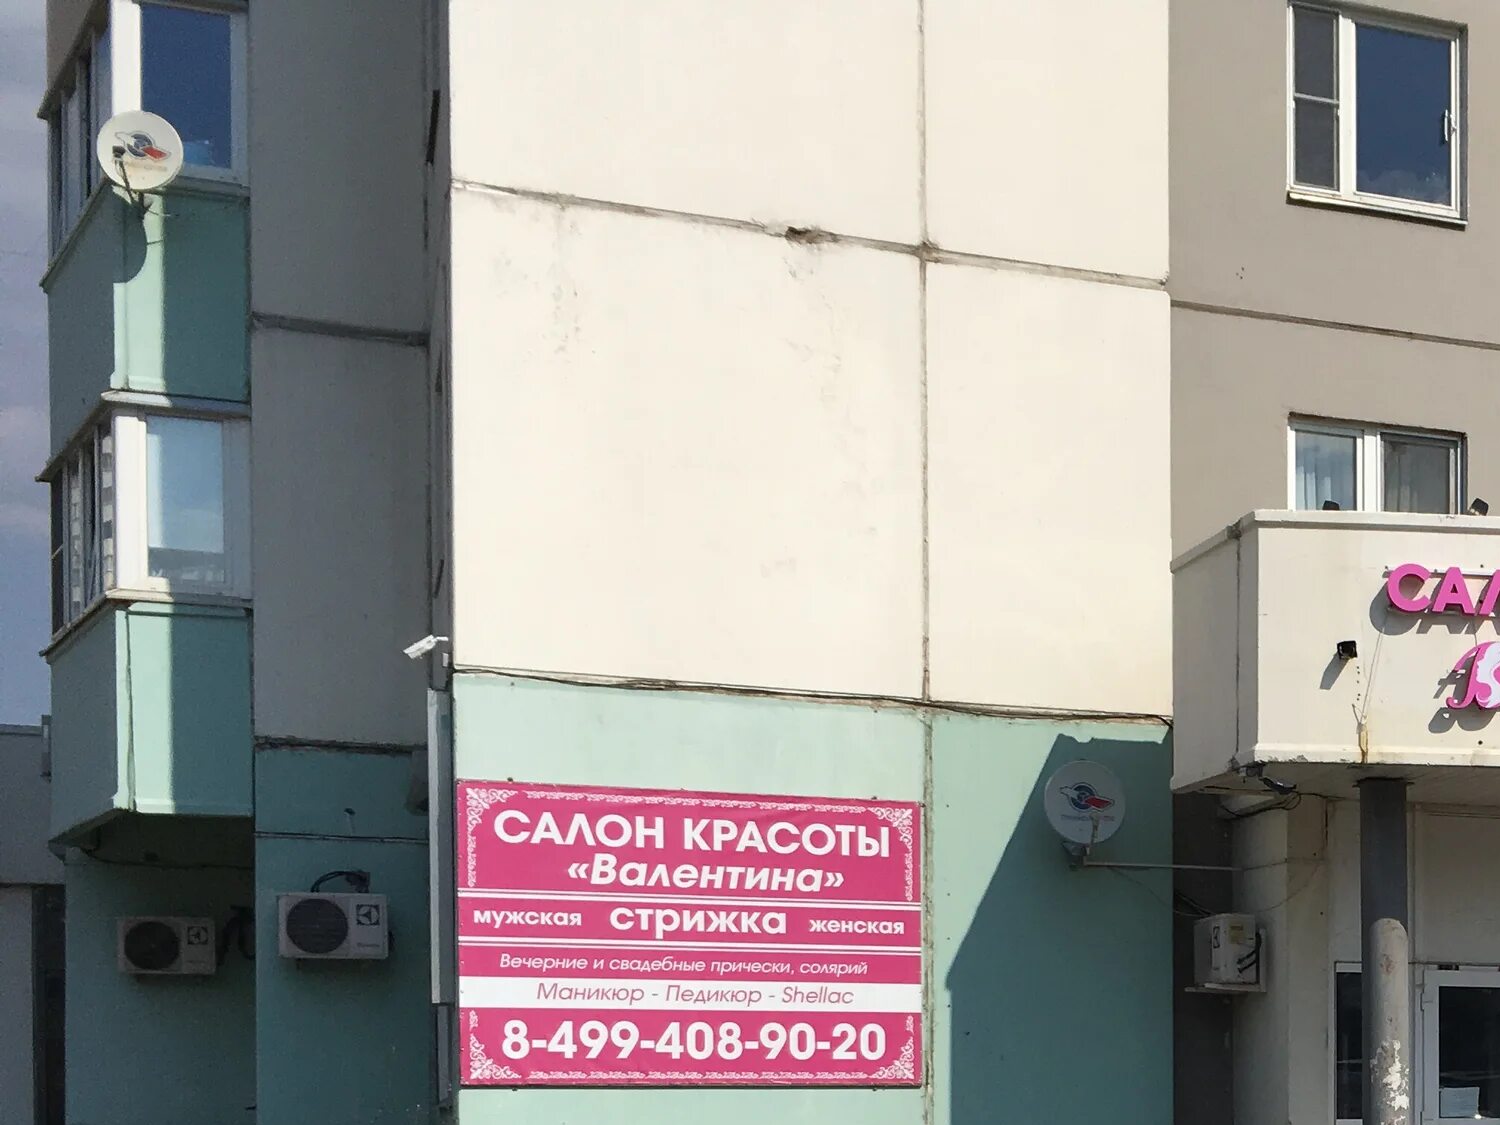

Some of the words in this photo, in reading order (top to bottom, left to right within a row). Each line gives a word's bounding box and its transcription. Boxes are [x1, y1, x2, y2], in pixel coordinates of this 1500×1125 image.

[493, 809, 665, 850] САЛОН
[683, 818, 891, 858] КРАСОТЫ
[567, 853, 845, 894] «Валентина»
[473, 906, 582, 928] мужская
[609, 903, 787, 939] стрижка
[808, 917, 905, 936] женская
[499, 953, 588, 971] Вечерние
[592, 957, 605, 970] и
[608, 955, 706, 974] свадебные
[711, 959, 795, 976] прически,
[799, 959, 868, 975] солярий
[536, 981, 645, 1004] Маникюр
[665, 984, 762, 1006] Педикюр
[781, 985, 854, 1005] Shellac
[501, 1018, 887, 1062] 8-499-408-90-20
